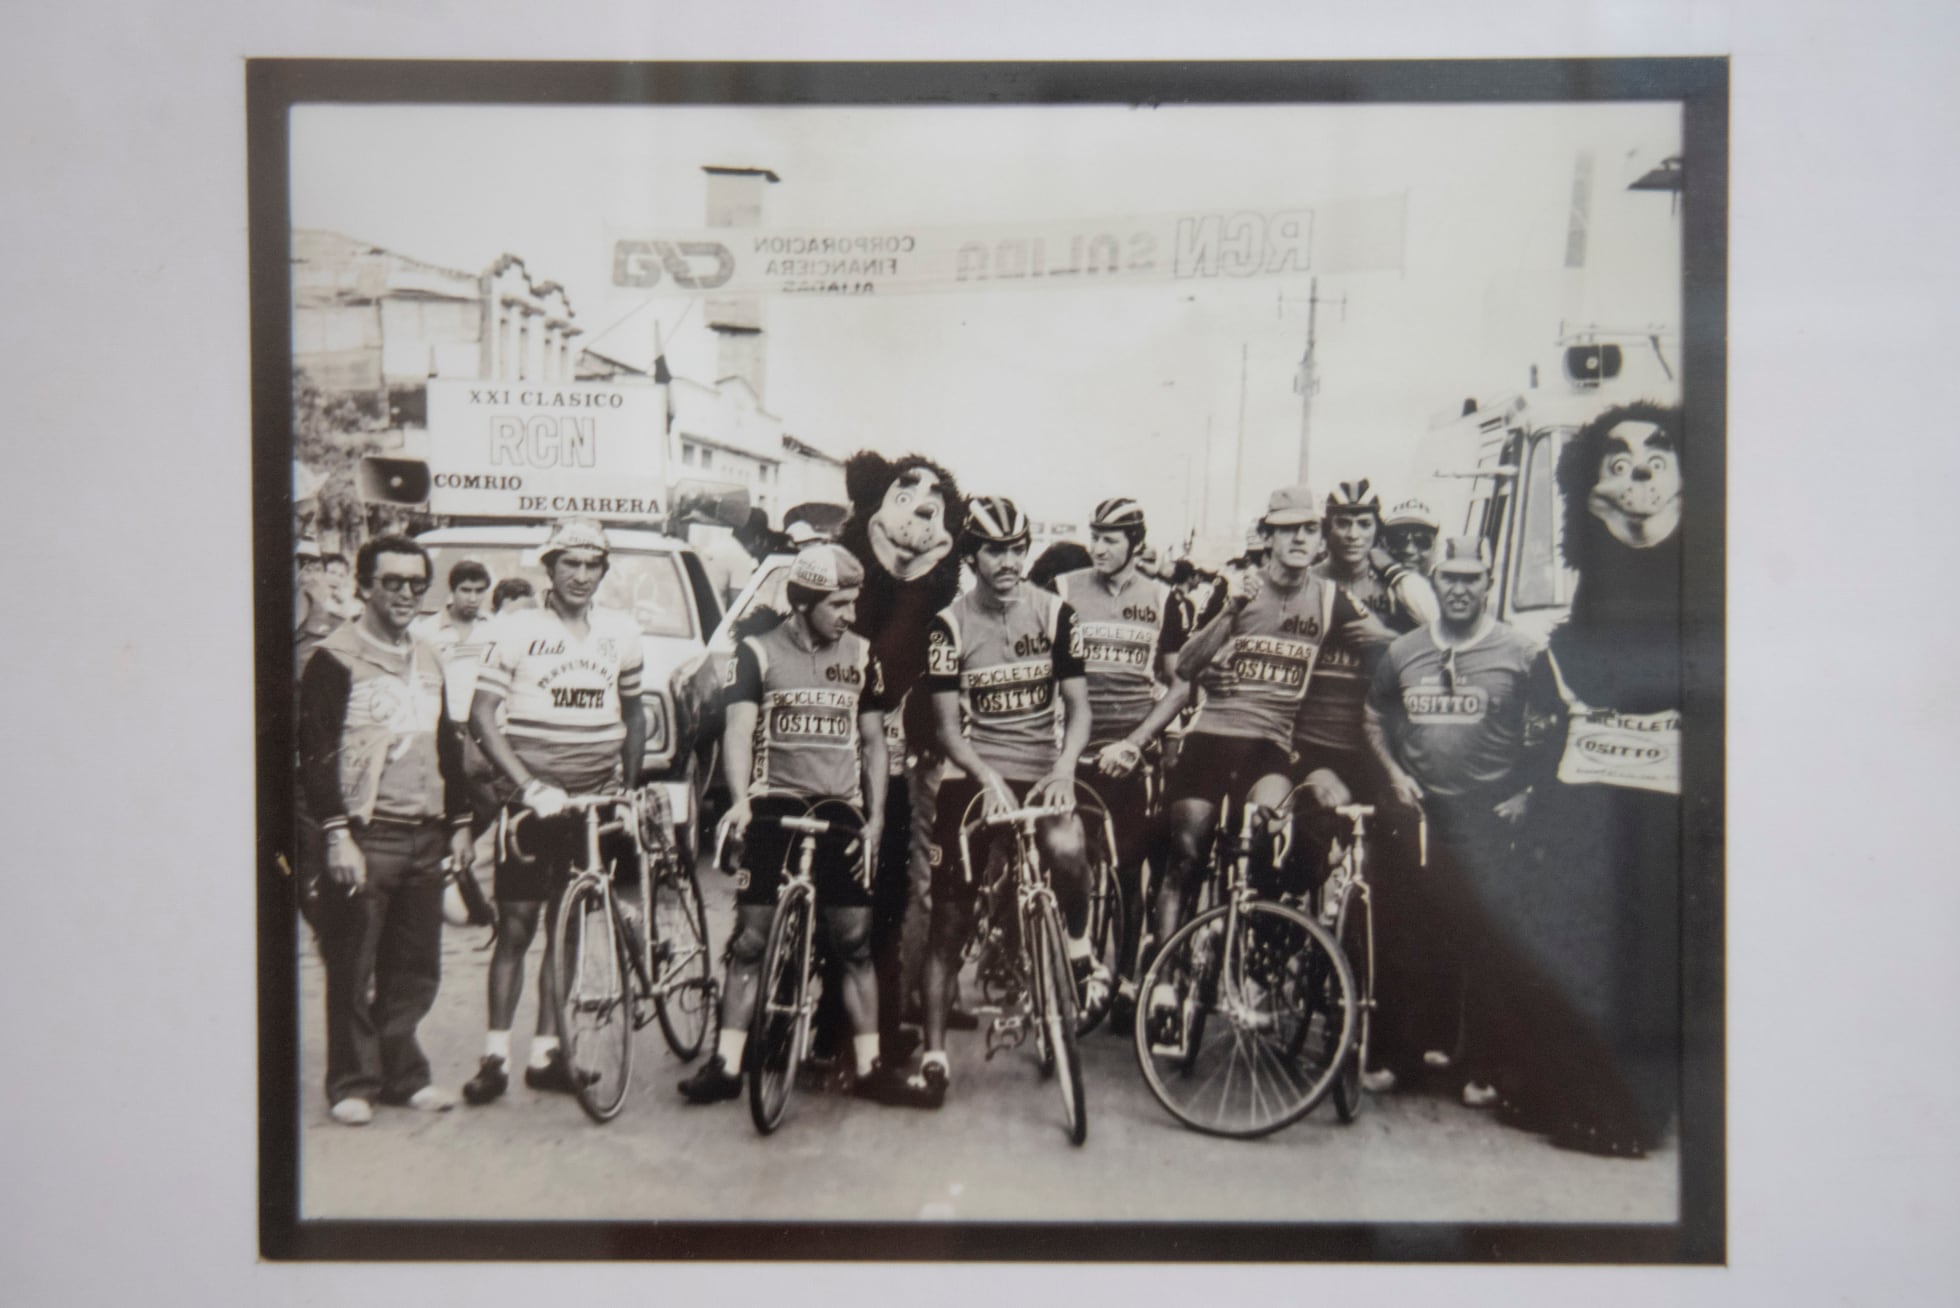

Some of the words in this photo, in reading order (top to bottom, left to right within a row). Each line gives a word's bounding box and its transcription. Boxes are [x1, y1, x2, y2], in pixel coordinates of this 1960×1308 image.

[470, 390, 510, 404] XXI
[520, 392, 624, 408] CLASICO
[489, 414, 596, 469] RCN
[434, 473, 522, 490] COMRIO
[518, 497, 547, 511] DE
[551, 497, 661, 514] CARRERA
[930, 648, 957, 672] 25
[1235, 659, 1301, 684] OSITTO
[978, 686, 1047, 712] OSITTO
[1408, 695, 1478, 714] OSITTO
[779, 713, 847, 736] OSITTO
[1584, 740, 1661, 759] OSITTO
